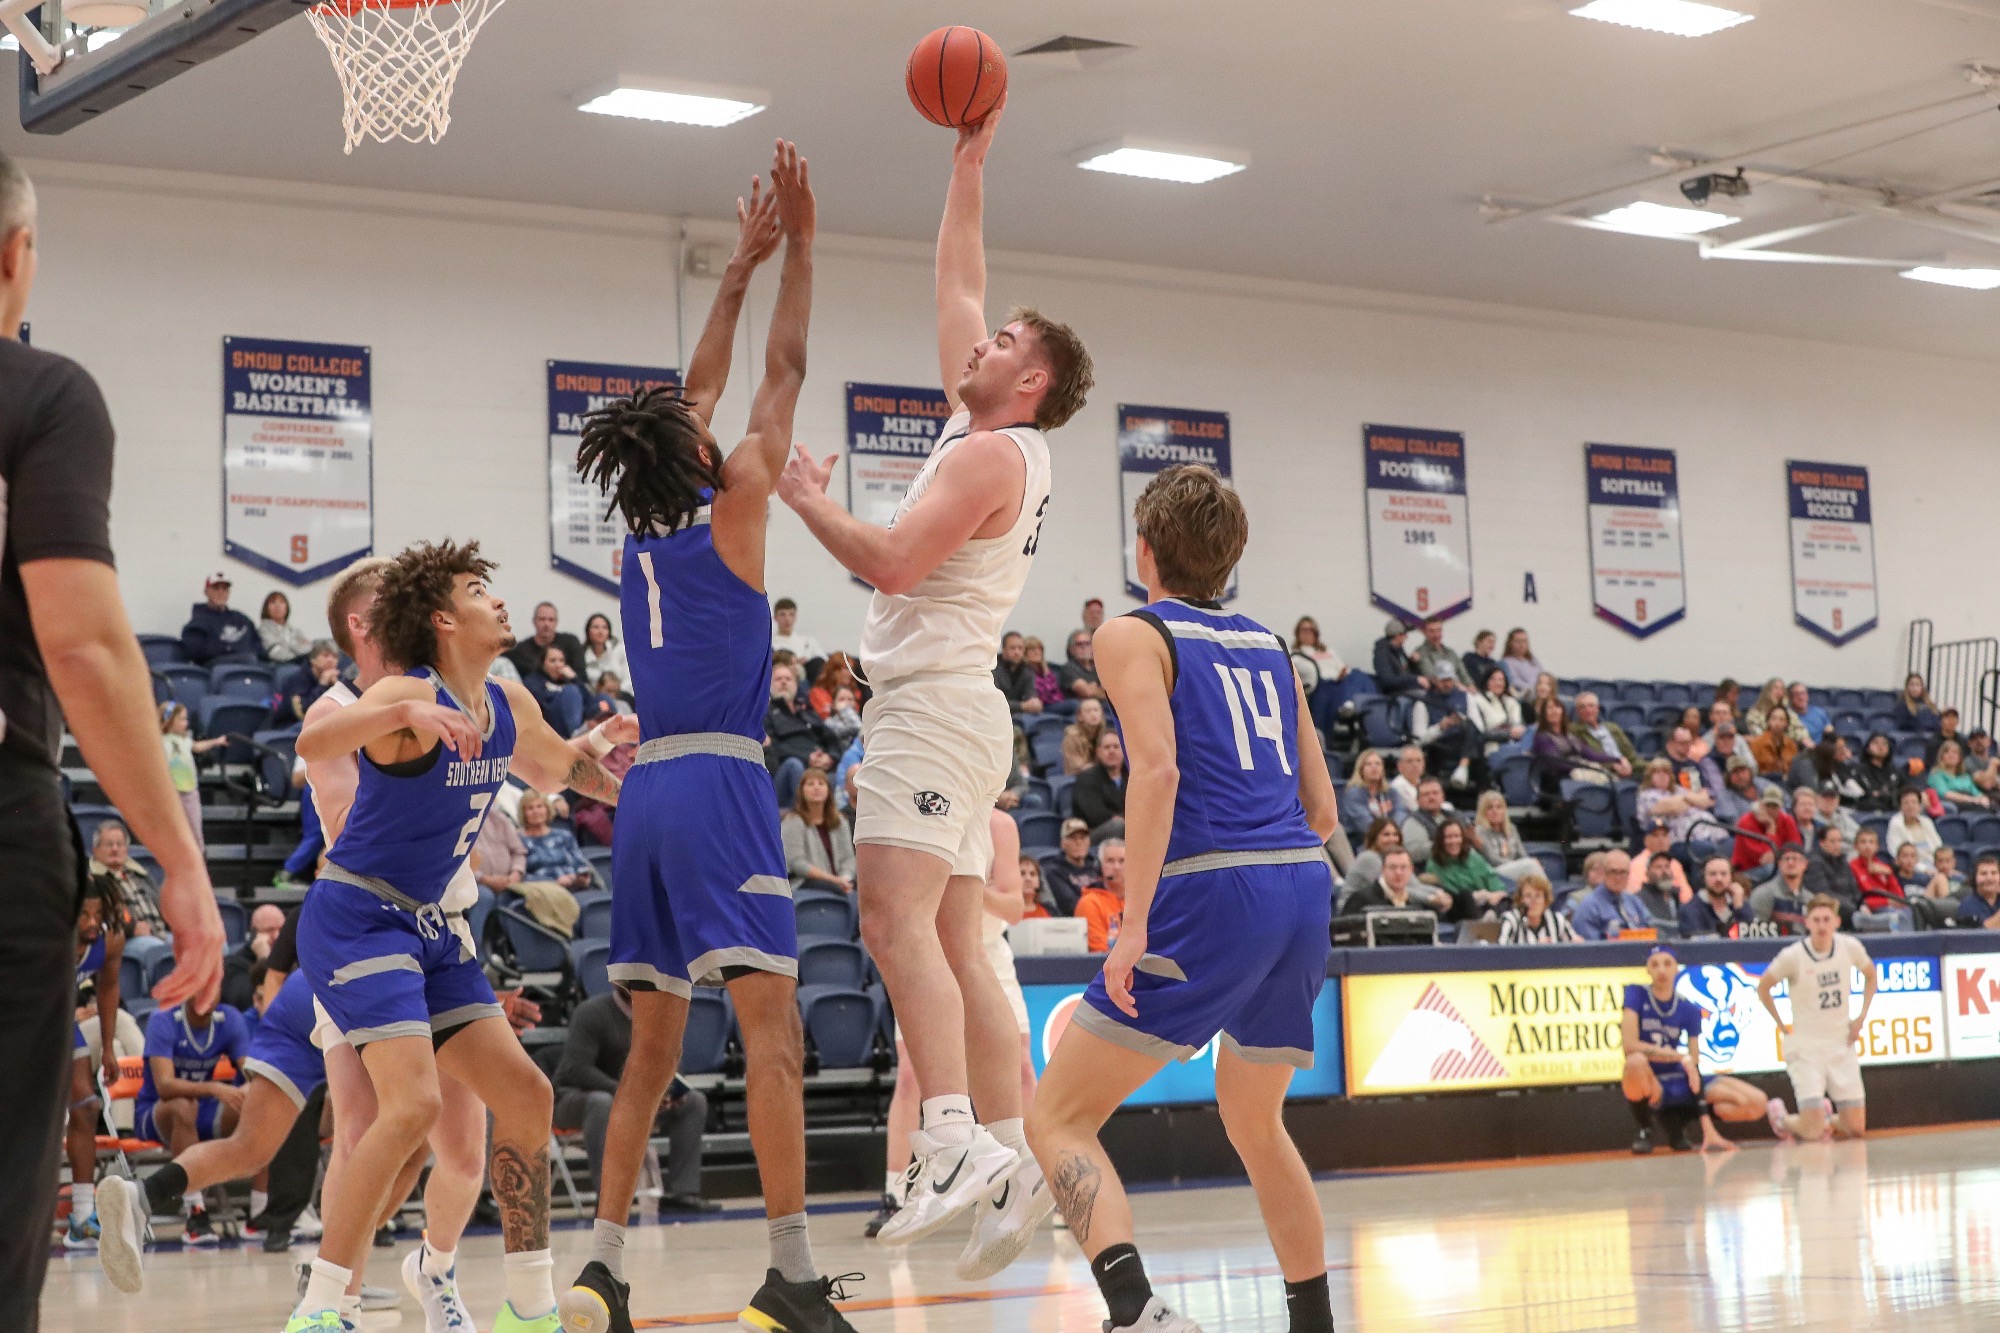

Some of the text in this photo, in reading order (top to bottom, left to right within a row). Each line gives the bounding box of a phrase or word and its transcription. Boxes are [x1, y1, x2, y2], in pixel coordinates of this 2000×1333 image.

[232, 350, 363, 377] SNOW COLLEGE
[249, 373, 347, 396] WOMEN'S
[555, 374, 602, 393] SNOW
[233, 392, 363, 417] BASKETBALL
[854, 396, 897, 413] SNOW
[883, 416, 937, 434] MEN'S
[855, 432, 935, 454] BASKETB
[1135, 444, 1217, 463] FOOTBALL
[1601, 478, 1665, 497] SOFTBALL
[1807, 503, 1855, 520] SOCCER
[291, 535, 309, 564] S
[1524, 571, 1538, 603] A
[637, 551, 663, 649] 1
[1212, 662, 1293, 776] 14
[445, 759, 491, 787] SOUTHERN
[452, 792, 492, 858] 2
[1489, 982, 1624, 1016] MOUNTA
[1818, 990, 1842, 1009] 23
[1505, 1020, 1622, 1054] AMERIC
